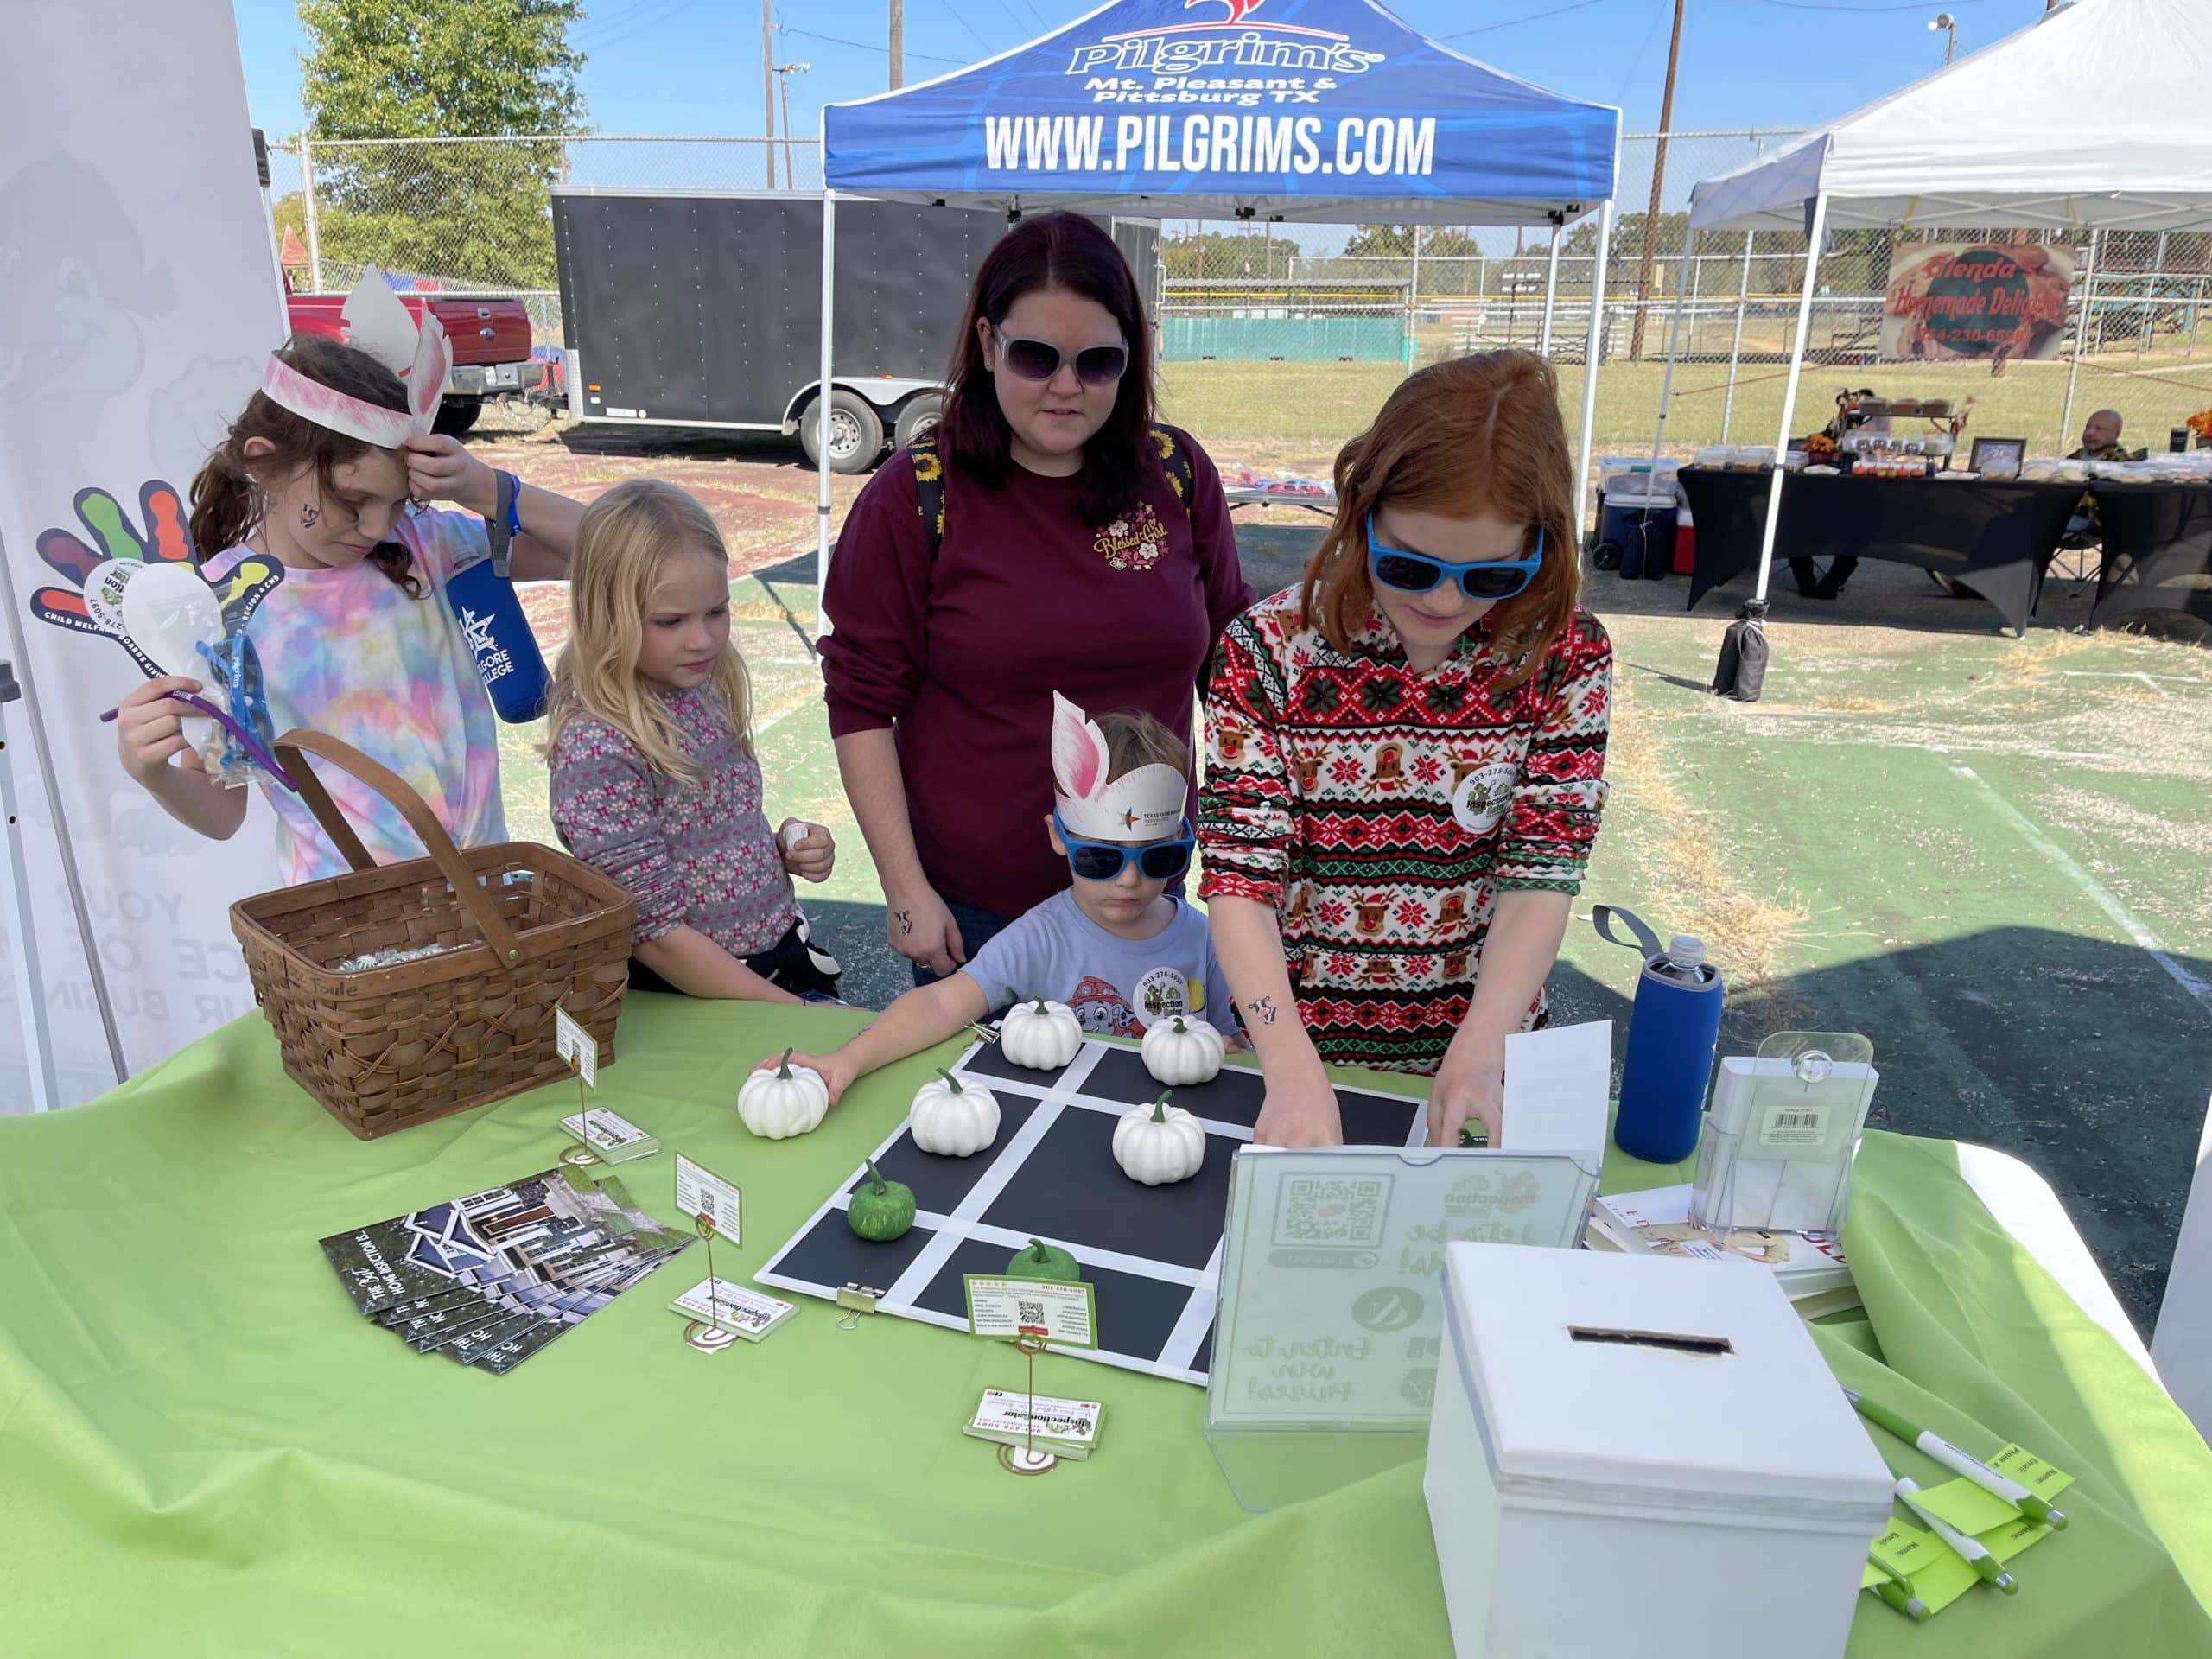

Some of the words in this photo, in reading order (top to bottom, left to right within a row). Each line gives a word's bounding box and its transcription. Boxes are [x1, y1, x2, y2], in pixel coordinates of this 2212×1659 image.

[1065, 32, 1371, 75] Pilgrim's
[1084, 77, 1143, 91] Mt.
[1153, 76, 1305, 91] Pleasant
[1313, 76, 1337, 90] &
[1094, 90, 1260, 106] Pittsburg
[1269, 91, 1320, 104] TX
[985, 114, 1436, 175] WWW.PILGRIMS.COM
[1895, 284, 1986, 321] Homemade
[1093, 531, 1141, 560] Blessed
[1139, 518, 1168, 543] Girl
[90, 599, 125, 630] -278-5097
[45, 612, 73, 625] CHILD
[145, 662, 170, 678] GIVIN
[477, 649, 510, 673] LGORE
[482, 661, 514, 685] LLEGE
[1466, 795, 1510, 809] Inspection
[1144, 1000, 1183, 1009] Inspection
[367, 1285, 386, 1300] THE
[382, 1273, 406, 1296] HOME
